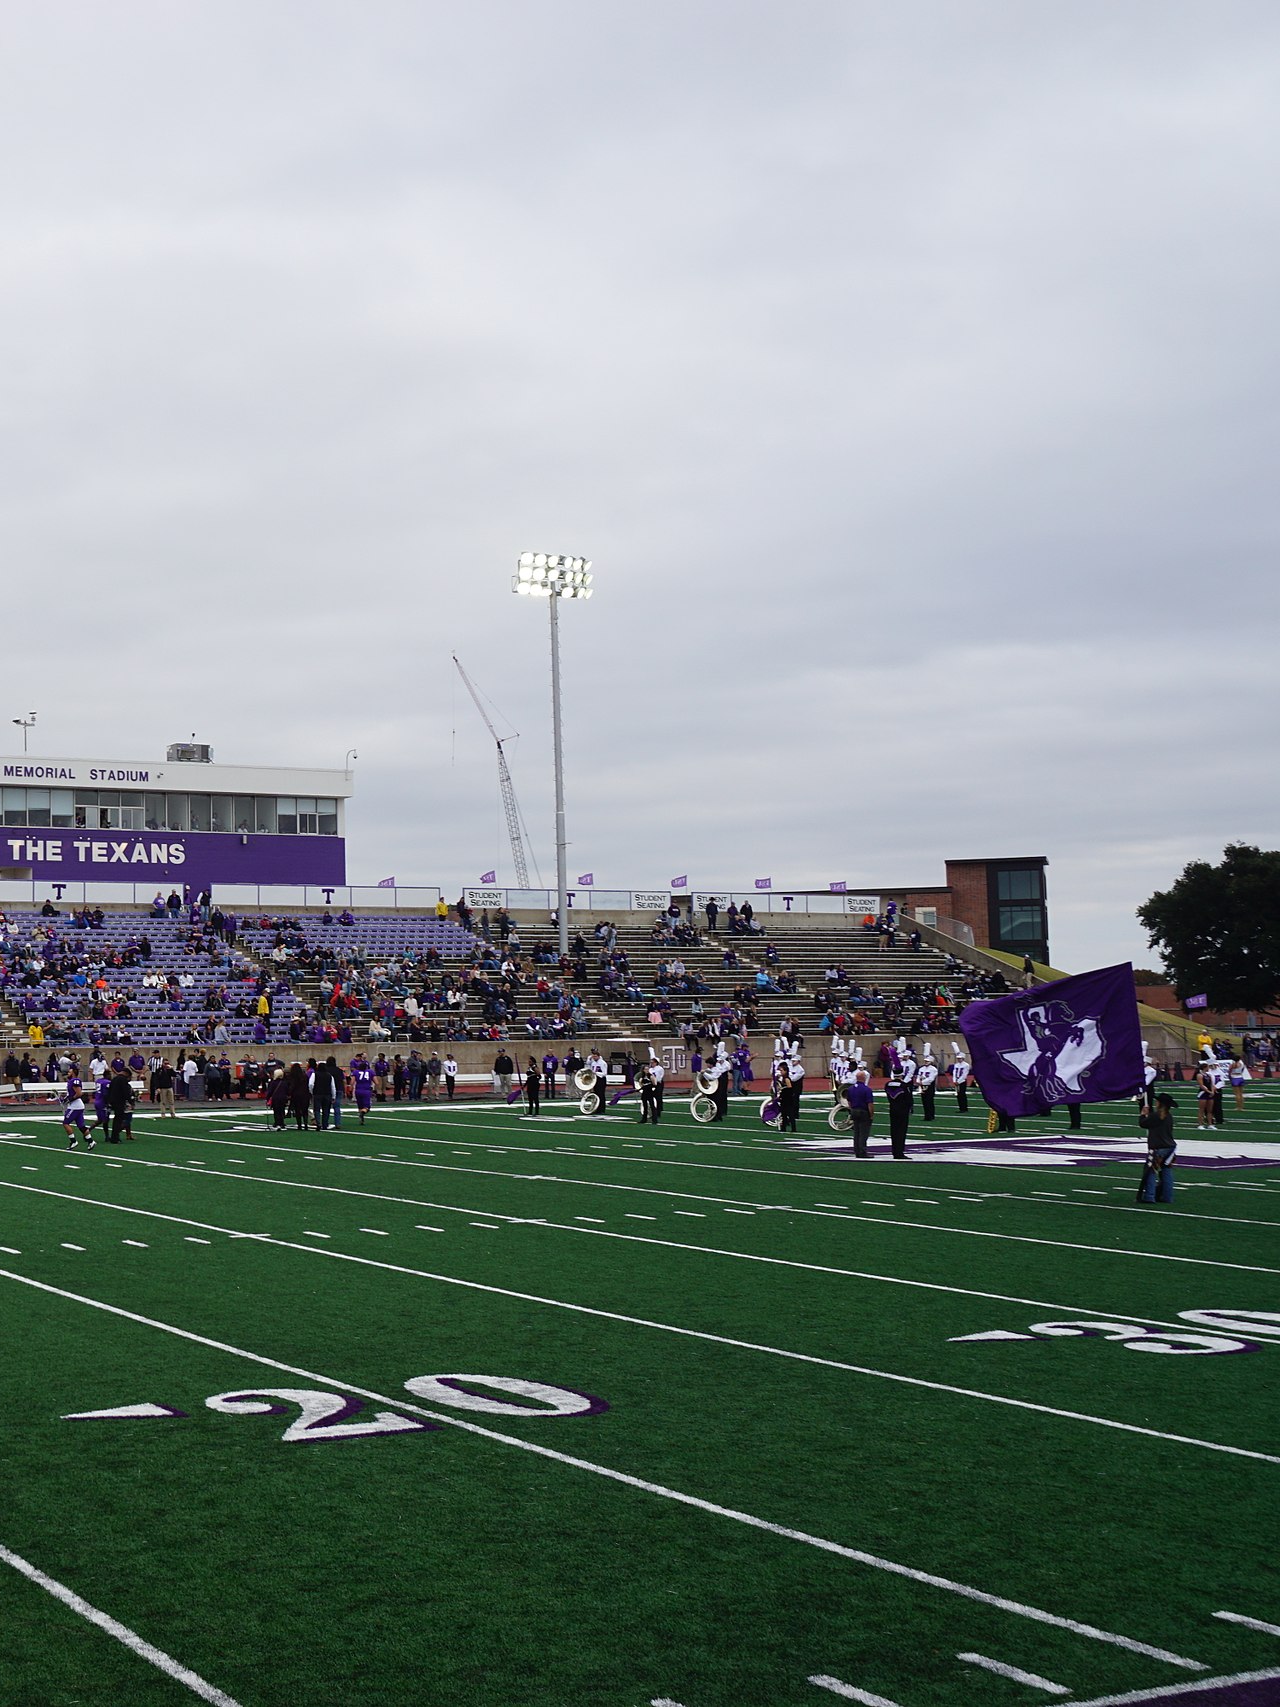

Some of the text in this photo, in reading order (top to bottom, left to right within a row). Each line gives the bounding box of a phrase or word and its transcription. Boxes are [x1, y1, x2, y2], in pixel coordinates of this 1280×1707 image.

[3, 765, 76, 779] MEMORIAL
[89, 769, 149, 782] STADIUM
[7, 840, 62, 861] THE
[74, 842, 186, 864] TEXANS
[52, 884, 67, 900] T
[321, 888, 335, 904] T
[468, 891, 503, 899] STUDENT
[634, 893, 667, 902] STUDENT
[847, 897, 876, 906] STUDENT
[470, 899, 501, 907] SEATING
[636, 901, 665, 909] SEATING
[782, 896, 794, 911] T
[849, 905, 875, 913] SEATING
[358, 1071, 370, 1080] 74
